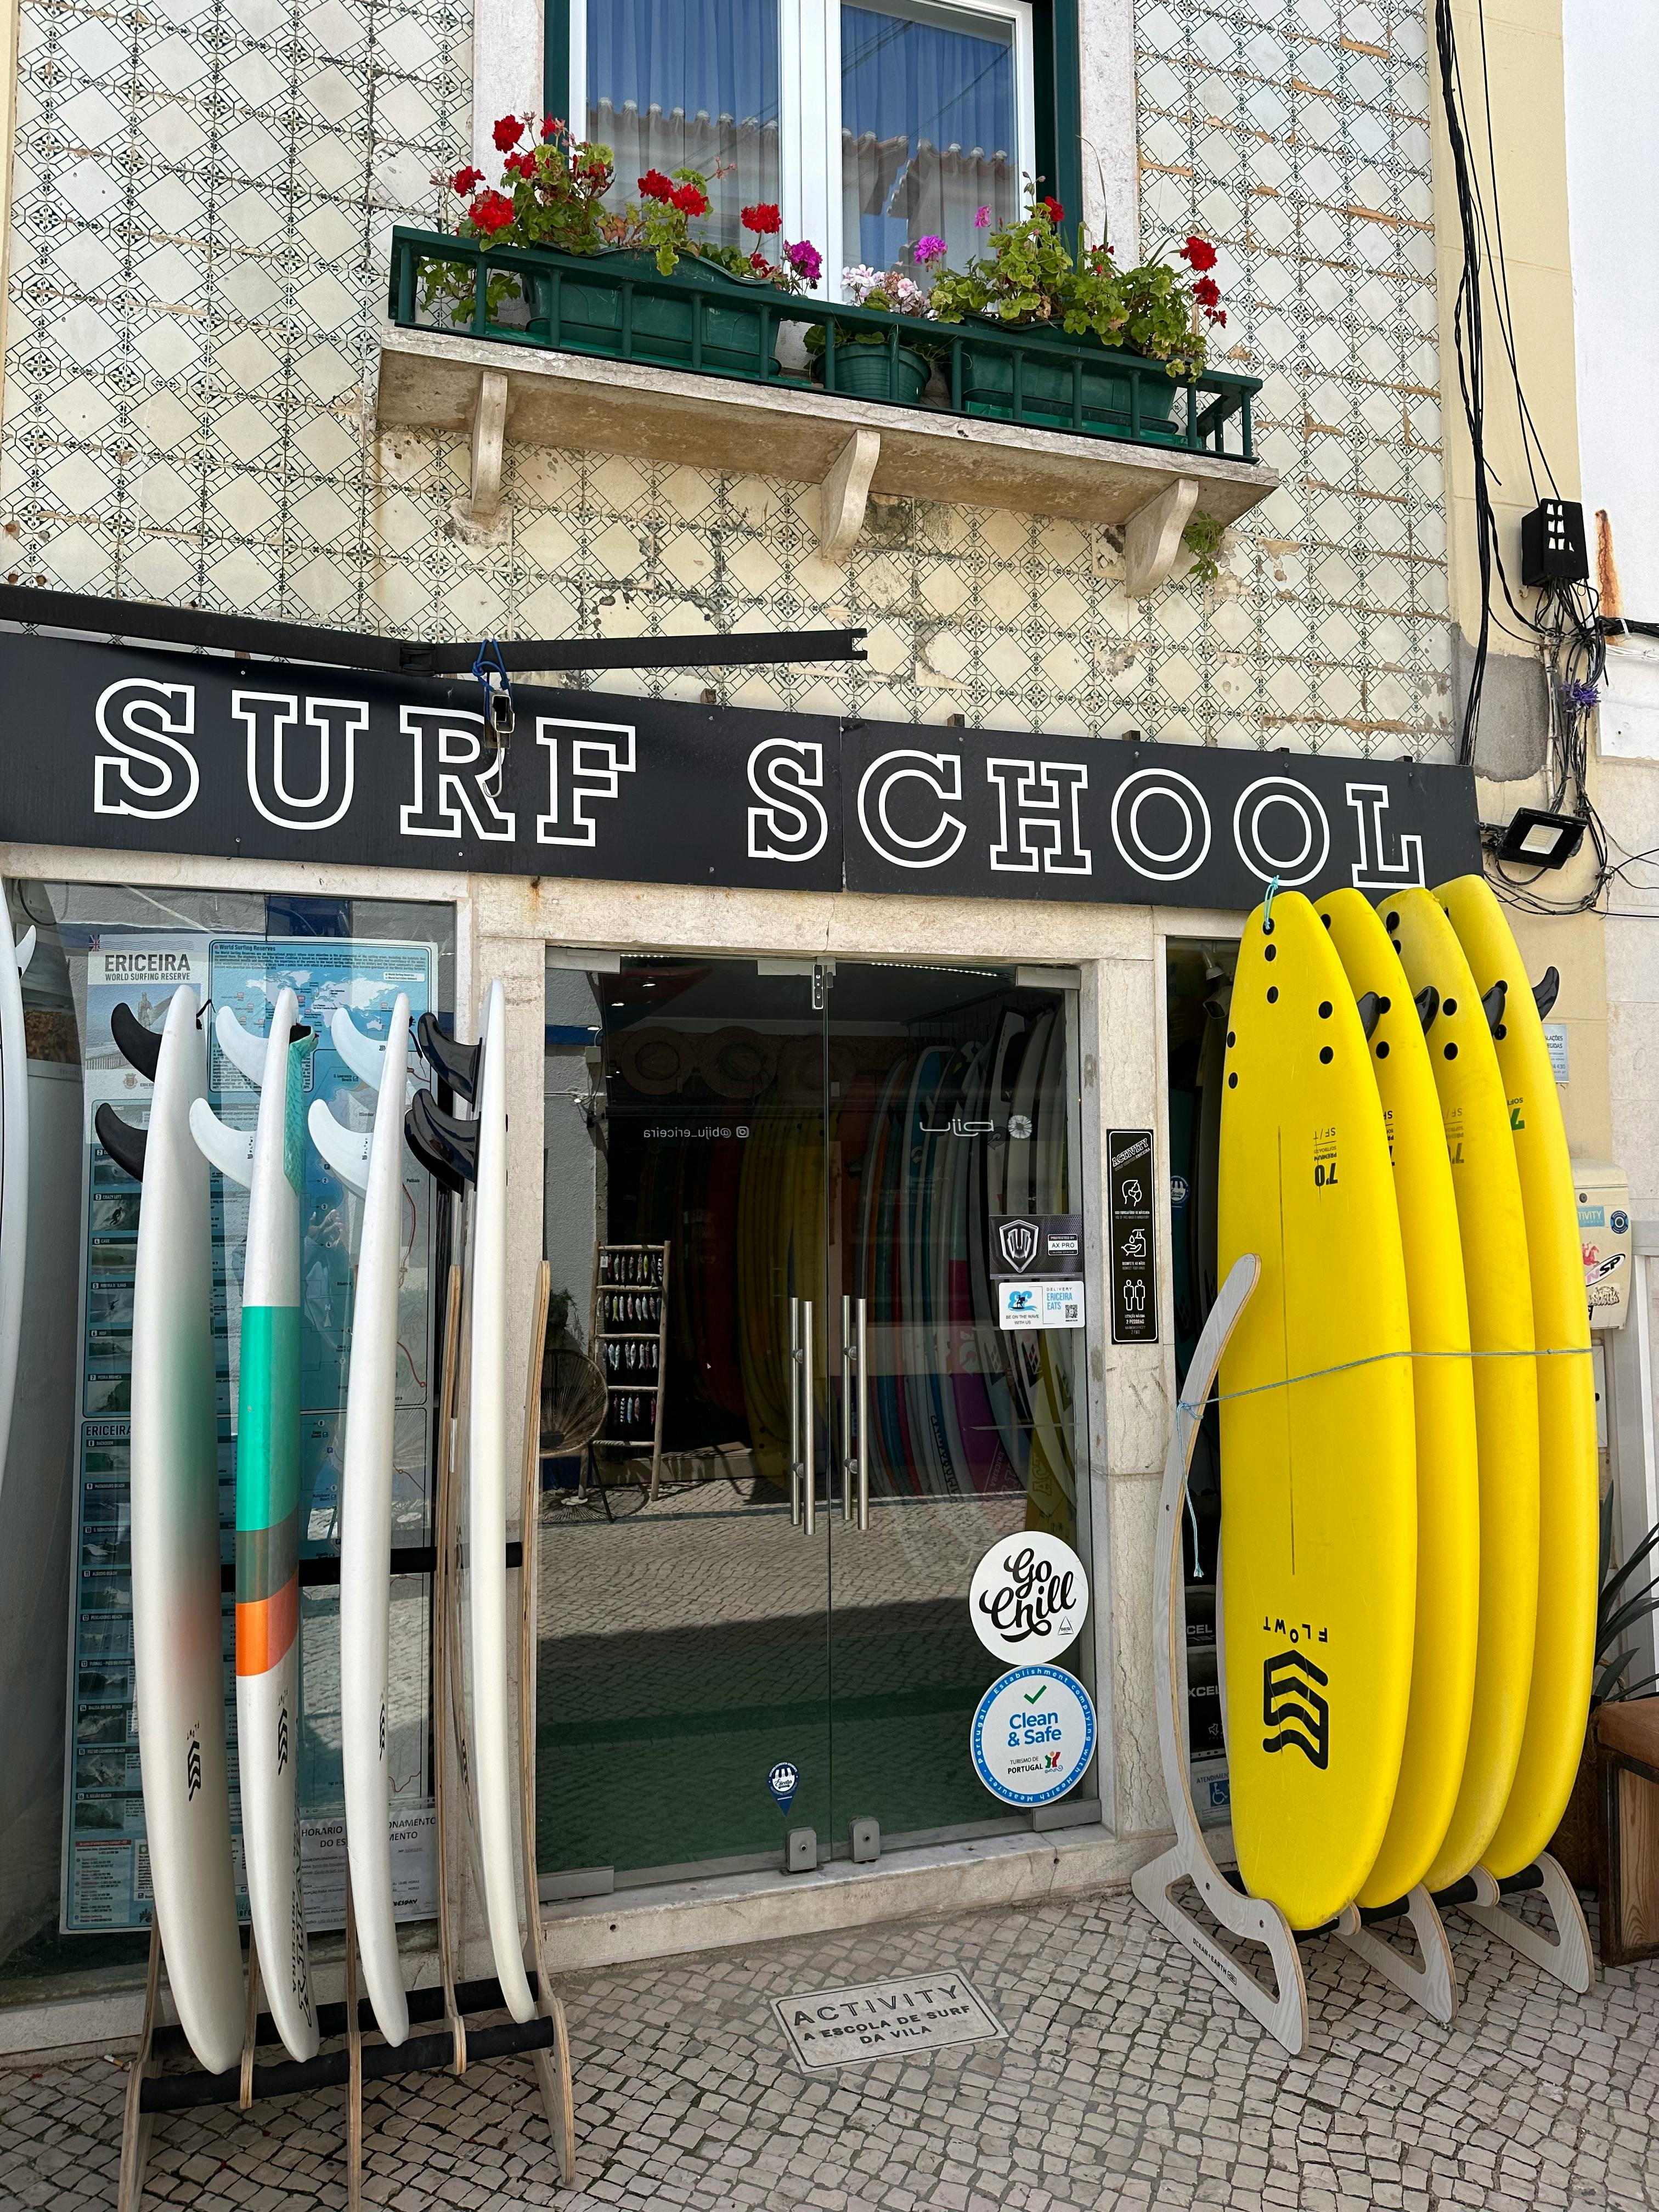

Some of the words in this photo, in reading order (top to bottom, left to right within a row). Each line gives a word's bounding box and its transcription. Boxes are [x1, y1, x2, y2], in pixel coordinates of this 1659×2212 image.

[94, 678, 636, 847] SURF
[747, 738, 1426, 888] SCHOOL
[105, 954, 190, 972] ERICEIRA
[161, 972, 190, 980] RESERVE
[1112, 1138, 1148, 1167] ACTIVITY
[1314, 1152, 1337, 1161] PREMIUM
[1047, 1293, 1073, 1301] ERICEIRA
[1047, 1302, 1061, 1310] EATS
[1003, 1548, 1052, 1599] Go
[979, 1571, 1076, 1643] Chill
[1186, 1624, 1213, 1635] CEL
[1263, 1616, 1328, 1643] FLOWT
[994, 1668, 1068, 1695] Establishment
[1009, 1712, 1058, 1729] Clean
[1071, 1685, 1092, 1742] complying
[975, 1709, 987, 1764] Portugal
[1008, 1731, 1020, 1747] &
[1024, 1726, 1062, 1745] Safe
[1008, 1763, 1043, 1774] PORTUGAL
[1010, 1757, 1031, 1765] TURISMO
[1075, 1748, 1089, 1773] with
[988, 1776, 1033, 1802] Measures
[1039, 1777, 1073, 1800] Health
[302, 1826, 343, 1837] HORARIO
[794, 1985, 956, 2026] ACTIVITY
[804, 2033, 815, 2041] A
[821, 2019, 891, 2038] ESCOLA
[897, 2014, 921, 2025] DE
[926, 2005, 970, 2019] SURF
[860, 2034, 885, 2044] DA
[890, 2025, 932, 2038] VILA
